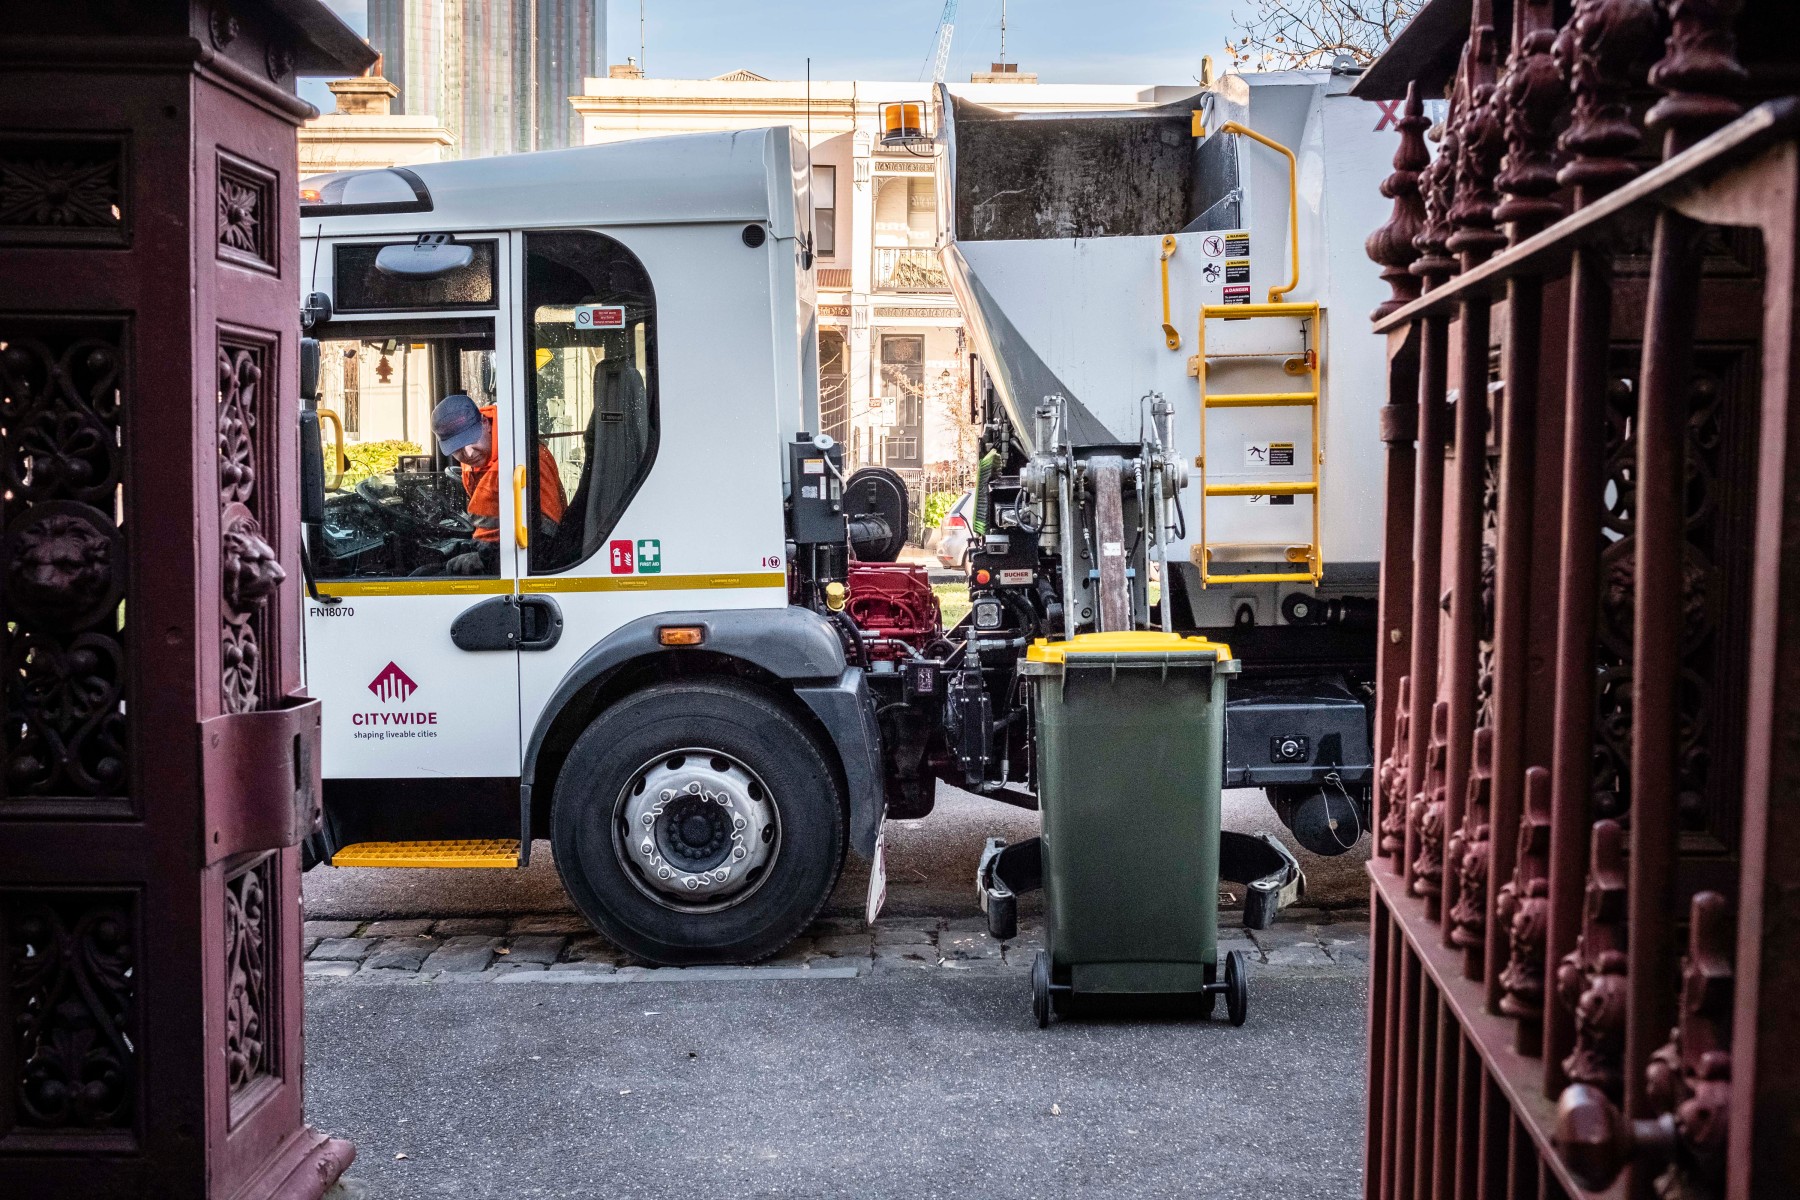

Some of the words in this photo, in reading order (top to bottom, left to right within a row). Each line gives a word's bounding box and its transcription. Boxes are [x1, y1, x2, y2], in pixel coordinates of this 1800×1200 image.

[310, 607, 355, 617] FN18070
[352, 712, 438, 726] CITYWIDE
[354, 731, 384, 740] shaping
[385, 730, 416, 738] liveable
[417, 730, 437, 738] cities
